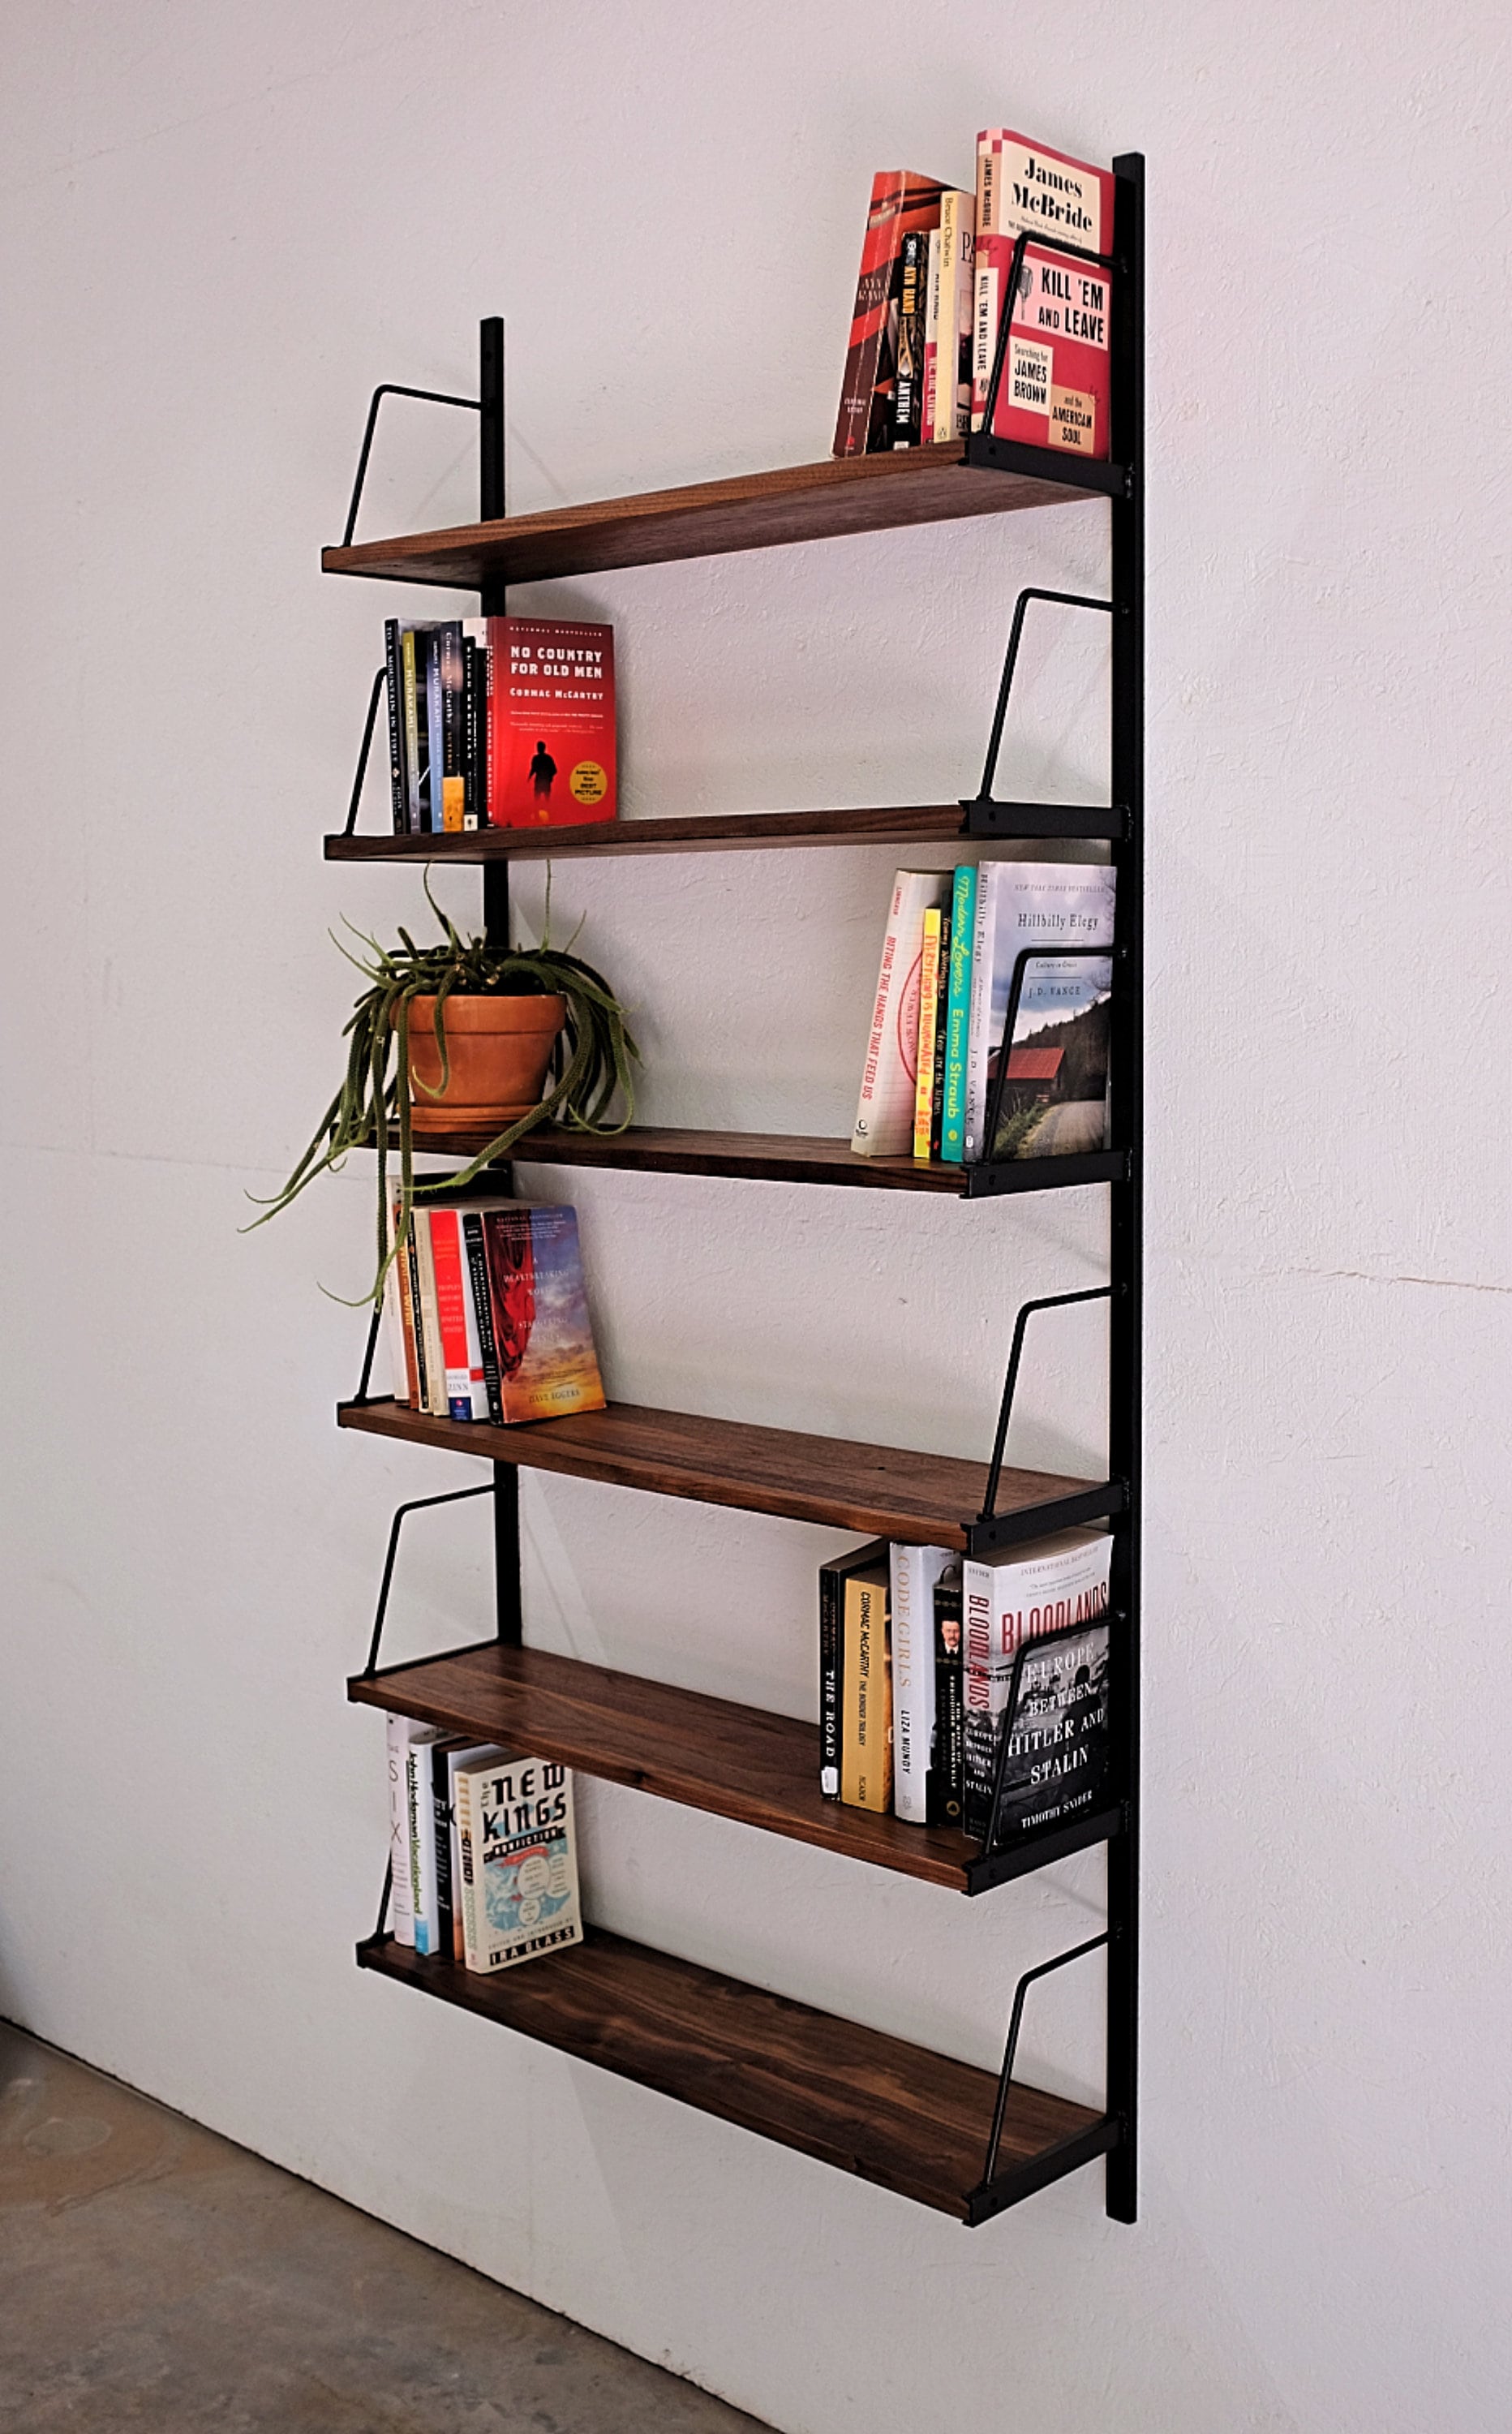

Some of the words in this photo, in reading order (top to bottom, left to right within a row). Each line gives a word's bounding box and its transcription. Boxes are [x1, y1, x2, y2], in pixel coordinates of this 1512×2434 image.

[984, 158, 993, 187] JAMES
[1024, 157, 1082, 198] James
[945, 197, 953, 224] Bruce
[1012, 183, 1092, 232] McBride
[943, 226, 953, 267] Chatwin
[902, 288, 916, 314] RAND
[979, 275, 989, 296] KILL
[1042, 267, 1072, 301] KILL
[1078, 279, 1103, 312] 'EM
[978, 320, 988, 340] AND
[1038, 306, 1059, 329] AND
[1064, 307, 1104, 344] LEAVE
[977, 342, 987, 371] LEAVE
[1014, 359, 1046, 383] JAMES
[896, 381, 912, 424] ANTHEM
[1013, 381, 1046, 405] BROWN
[1064, 396, 1074, 406] and
[1051, 406, 1092, 428] AMERICAN
[1062, 427, 1081, 445] SOUL
[510, 646, 530, 658] NO
[537, 647, 602, 663] COUNTRY
[510, 662, 538, 674] FOR
[543, 664, 569, 676] OLD
[574, 666, 602, 678] MEN
[388, 655, 396, 712] MOUNTAIN
[406, 669, 415, 728] MURAKAMI
[433, 668, 442, 728] MURAKAMI
[509, 687, 551, 697] CORMAC
[555, 690, 604, 700] McCARTHY
[955, 875, 970, 938] Modern
[1018, 914, 1066, 931] Hillbilly
[1069, 914, 1098, 931] Elegy
[883, 935, 896, 970] BITING
[952, 935, 969, 997] Lovers
[878, 974, 891, 992] THE
[1050, 986, 1080, 996] VANCE
[873, 995, 887, 1030] HANDS
[870, 1031, 882, 1055] THAT
[951, 1008, 964, 1058] Emma
[865, 1057, 878, 1084] FEED
[861, 1086, 874, 1100] US
[948, 1062, 962, 1119] Straub
[530, 1393, 549, 1404] DAVE
[897, 1555, 910, 1616] CODE
[861, 1591, 871, 1630] CORMAC
[860, 1631, 870, 1678] McCARTHY
[898, 1622, 911, 1687] GIRLS
[969, 1595, 990, 1709] BLOODLANDS
[1026, 1642, 1095, 1684] EUROPE
[826, 1671, 835, 1703] THE
[1029, 1683, 1091, 1717] BETWEEN
[826, 1711, 835, 1757] ROAD
[900, 1710, 910, 1733] LIZA
[1007, 1719, 1074, 1757] HITLER
[1080, 1708, 1104, 1732] AND
[409, 1750, 418, 1778] John
[902, 1738, 911, 1774] MUNDY
[1030, 1744, 1089, 1785] STALIN
[965, 1780, 993, 1795] STALIN
[410, 1779, 419, 1838] Hodgman
[1021, 1807, 1060, 1829] TIMOTHY
[1063, 1790, 1093, 1813] SNYDER
[411, 1838, 423, 1915] Vacationland
[492, 1947, 518, 1963] IRA
[526, 1927, 572, 1953] GLASS
